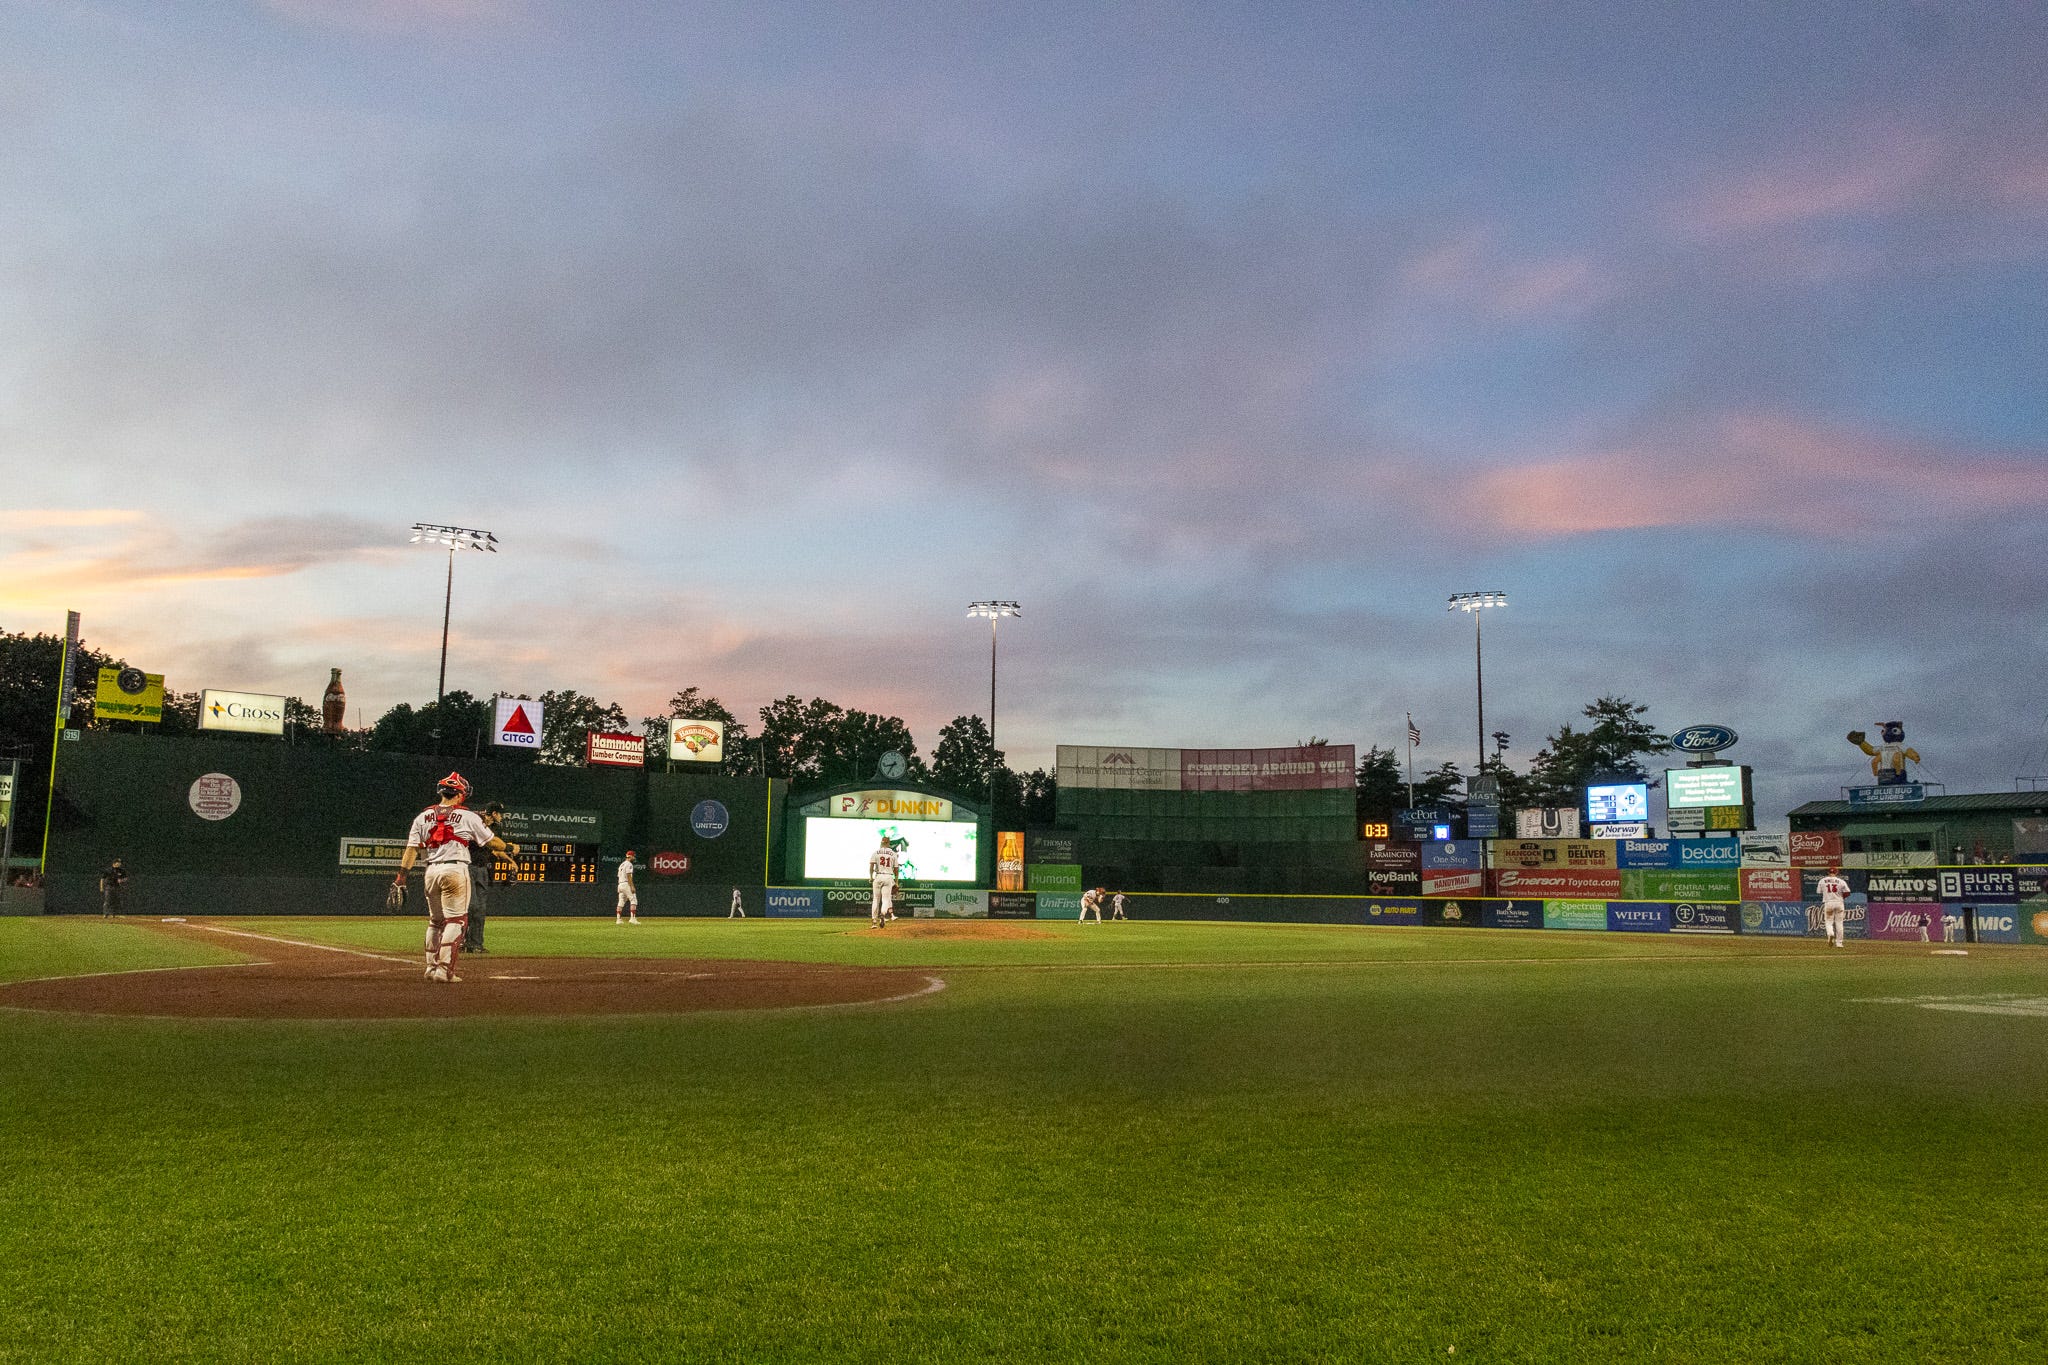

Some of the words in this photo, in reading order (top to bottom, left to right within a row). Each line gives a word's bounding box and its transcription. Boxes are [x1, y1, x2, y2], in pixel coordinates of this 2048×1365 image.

[66, 731, 78, 740] 315
[502, 733, 534, 744] CITGO
[679, 727, 715, 740] Hannaford
[1682, 730, 1720, 747] Ford
[592, 734, 645, 752] Hammond
[592, 750, 614, 760] Lumber
[615, 752, 643, 763] Company
[1075, 766, 1100, 775] Maine
[1103, 766, 1135, 776] Medical
[1137, 767, 1163, 777] Center
[1187, 763, 1258, 776] CENTERED
[1261, 761, 1316, 776] AROUND
[1319, 760, 1350, 774] YOU.
[1468, 793, 1496, 801] MAST
[1859, 789, 1871, 797] BIG
[1873, 788, 1893, 796] BLUE
[1895, 787, 1912, 795] BUG
[876, 799, 943, 815] DUNKIN'
[532, 813, 597, 824] DYNAMICS
[1410, 810, 1438, 820] cPort
[1365, 823, 1388, 838] 0:33
[1605, 825, 1640, 835] Norway
[541, 843, 548, 854] 0
[552, 845, 565, 853] OUT
[565, 844, 572, 854] 0
[1043, 839, 1072, 847] THOMAS
[1625, 840, 1669, 853] Bangor
[348, 845, 372, 858] JOE
[1370, 851, 1417, 859] FARMINGTON
[1567, 850, 1606, 859] DELIVER
[1681, 843, 1740, 859] bedard
[653, 857, 688, 870] Hood
[880, 856, 891, 868] 21
[1433, 855, 1449, 864] One
[1450, 855, 1468, 865] Stop
[1568, 858, 1588, 866] SINCE
[494, 863, 501, 871] 0
[501, 863, 508, 871] 0
[524, 863, 530, 871] 0
[539, 863, 546, 872] 0
[570, 864, 577, 873] 2
[581, 864, 587, 873] 5
[590, 864, 596, 873] 2
[494, 873, 500, 881] 0
[501, 873, 508, 881] 0
[516, 873, 523, 882] 0
[523, 873, 530, 882] 0
[530, 873, 536, 882] 0
[539, 874, 546, 882] 2
[580, 874, 587, 883] 8
[589, 874, 596, 883] 0
[1031, 872, 1077, 884] Humana
[1368, 871, 1419, 883] KeyBank
[1499, 871, 1567, 887] Emerson
[1567, 878, 1621, 889] Toyota.com
[1772, 870, 1791, 881] PG
[1964, 873, 2014, 884] BURR
[1433, 875, 1471, 889] HANDYMAN
[1748, 880, 1774, 890] Portland
[1867, 878, 1938, 892] AMATO'S
[1708, 884, 1731, 892] MAINE
[1964, 884, 2015, 892] SIGNS
[905, 893, 933, 901] MILLION
[1673, 890, 1702, 898] POWER
[769, 896, 811, 907] unum
[1040, 897, 1081, 909] UniFirst
[1383, 906, 1400, 915] AUTO
[1400, 907, 1417, 916] PARTS
[1496, 908, 1509, 916] Bath
[1561, 902, 1604, 914] Spectrum
[1765, 902, 1801, 917] MANN
[1615, 911, 1662, 921] WIPFLI
[1698, 913, 1726, 924] Tyson
[1770, 916, 1796, 929] LAW
[1954, 916, 2013, 932] MMIC
